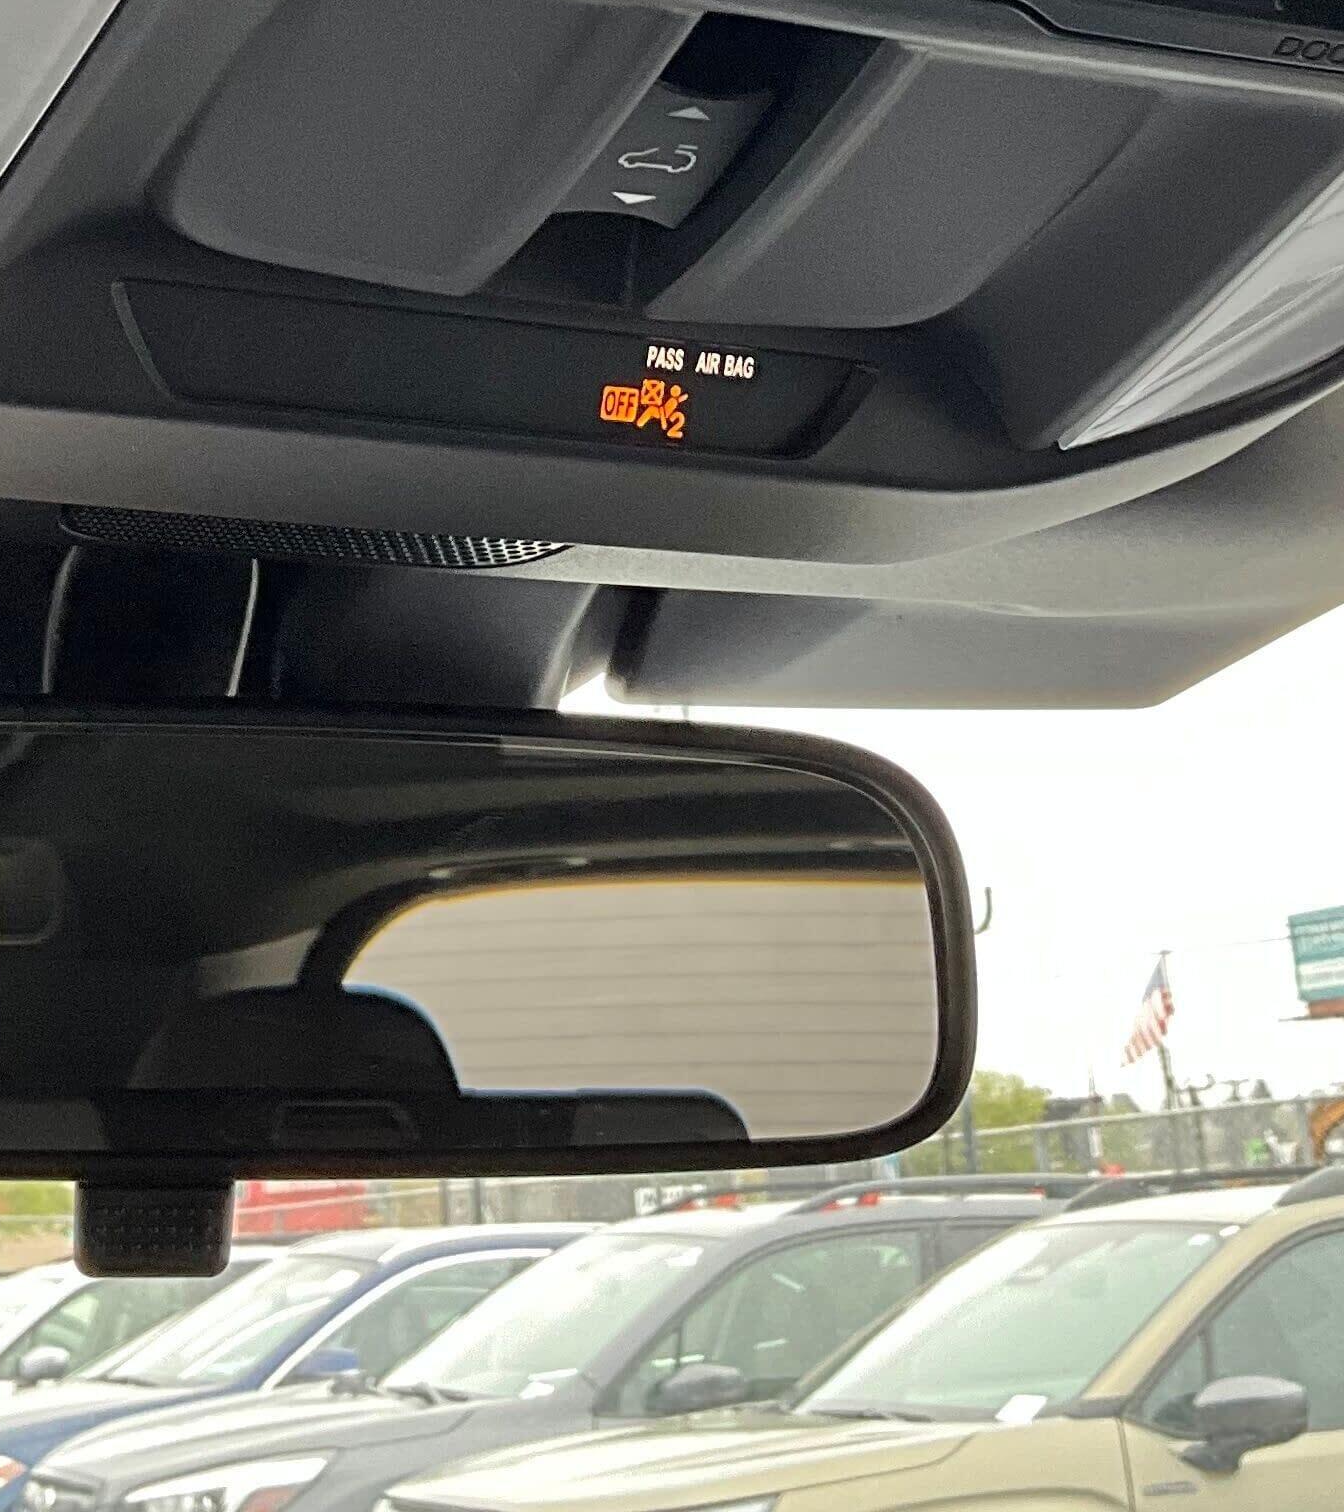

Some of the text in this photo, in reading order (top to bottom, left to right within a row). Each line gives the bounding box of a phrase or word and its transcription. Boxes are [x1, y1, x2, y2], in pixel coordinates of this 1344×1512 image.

[646, 345, 755, 380] PASS AIR BAG
[605, 390, 637, 418] OFF
[666, 411, 685, 438] 2
